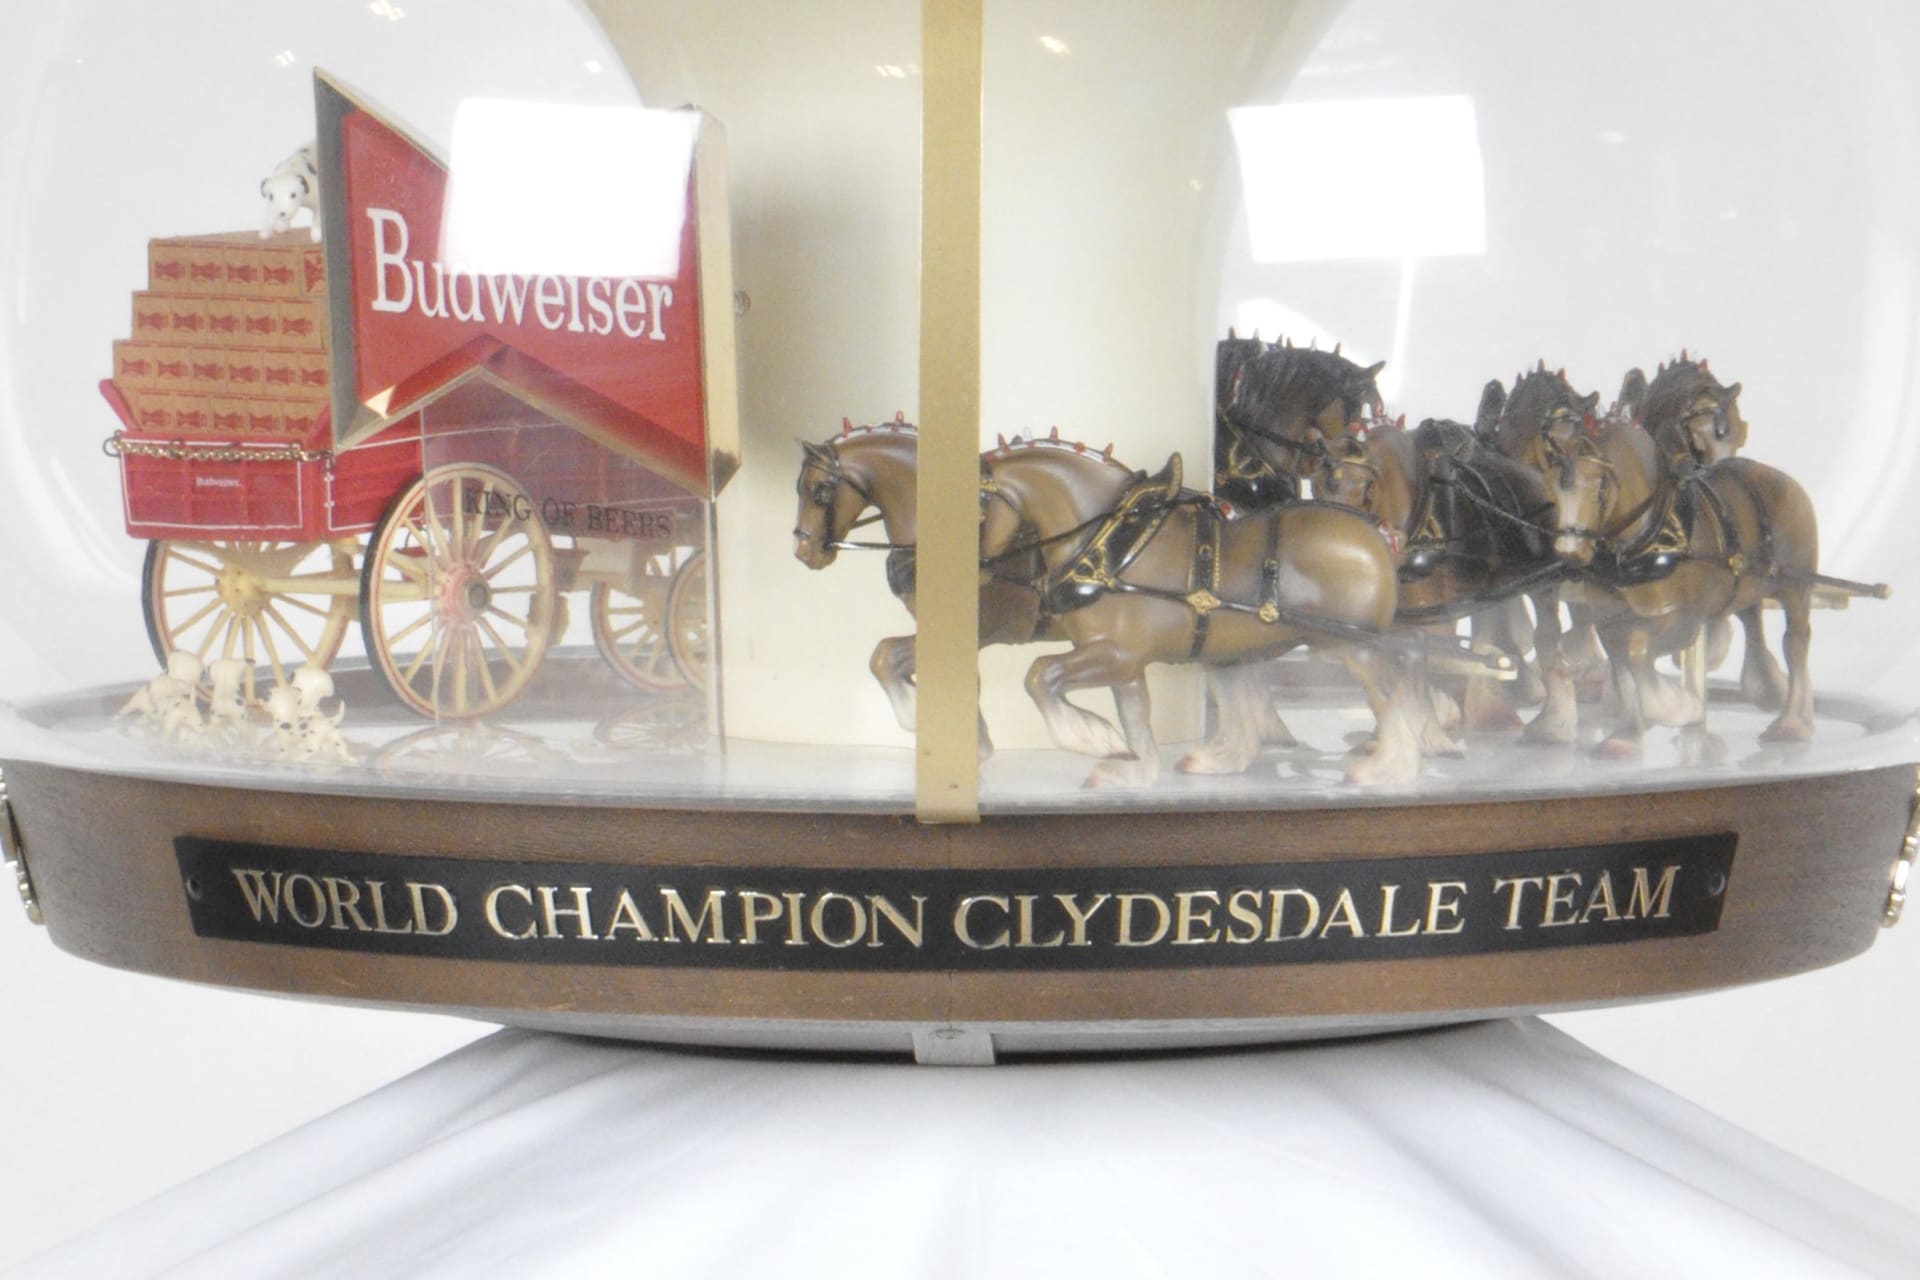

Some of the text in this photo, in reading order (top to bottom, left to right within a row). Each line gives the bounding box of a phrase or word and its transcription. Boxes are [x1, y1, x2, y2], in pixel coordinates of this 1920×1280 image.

[463, 489, 672, 537] KING OF BEERS
[232, 864, 1682, 949] WORLD CHAMPION CLYDESDALE TEAM
